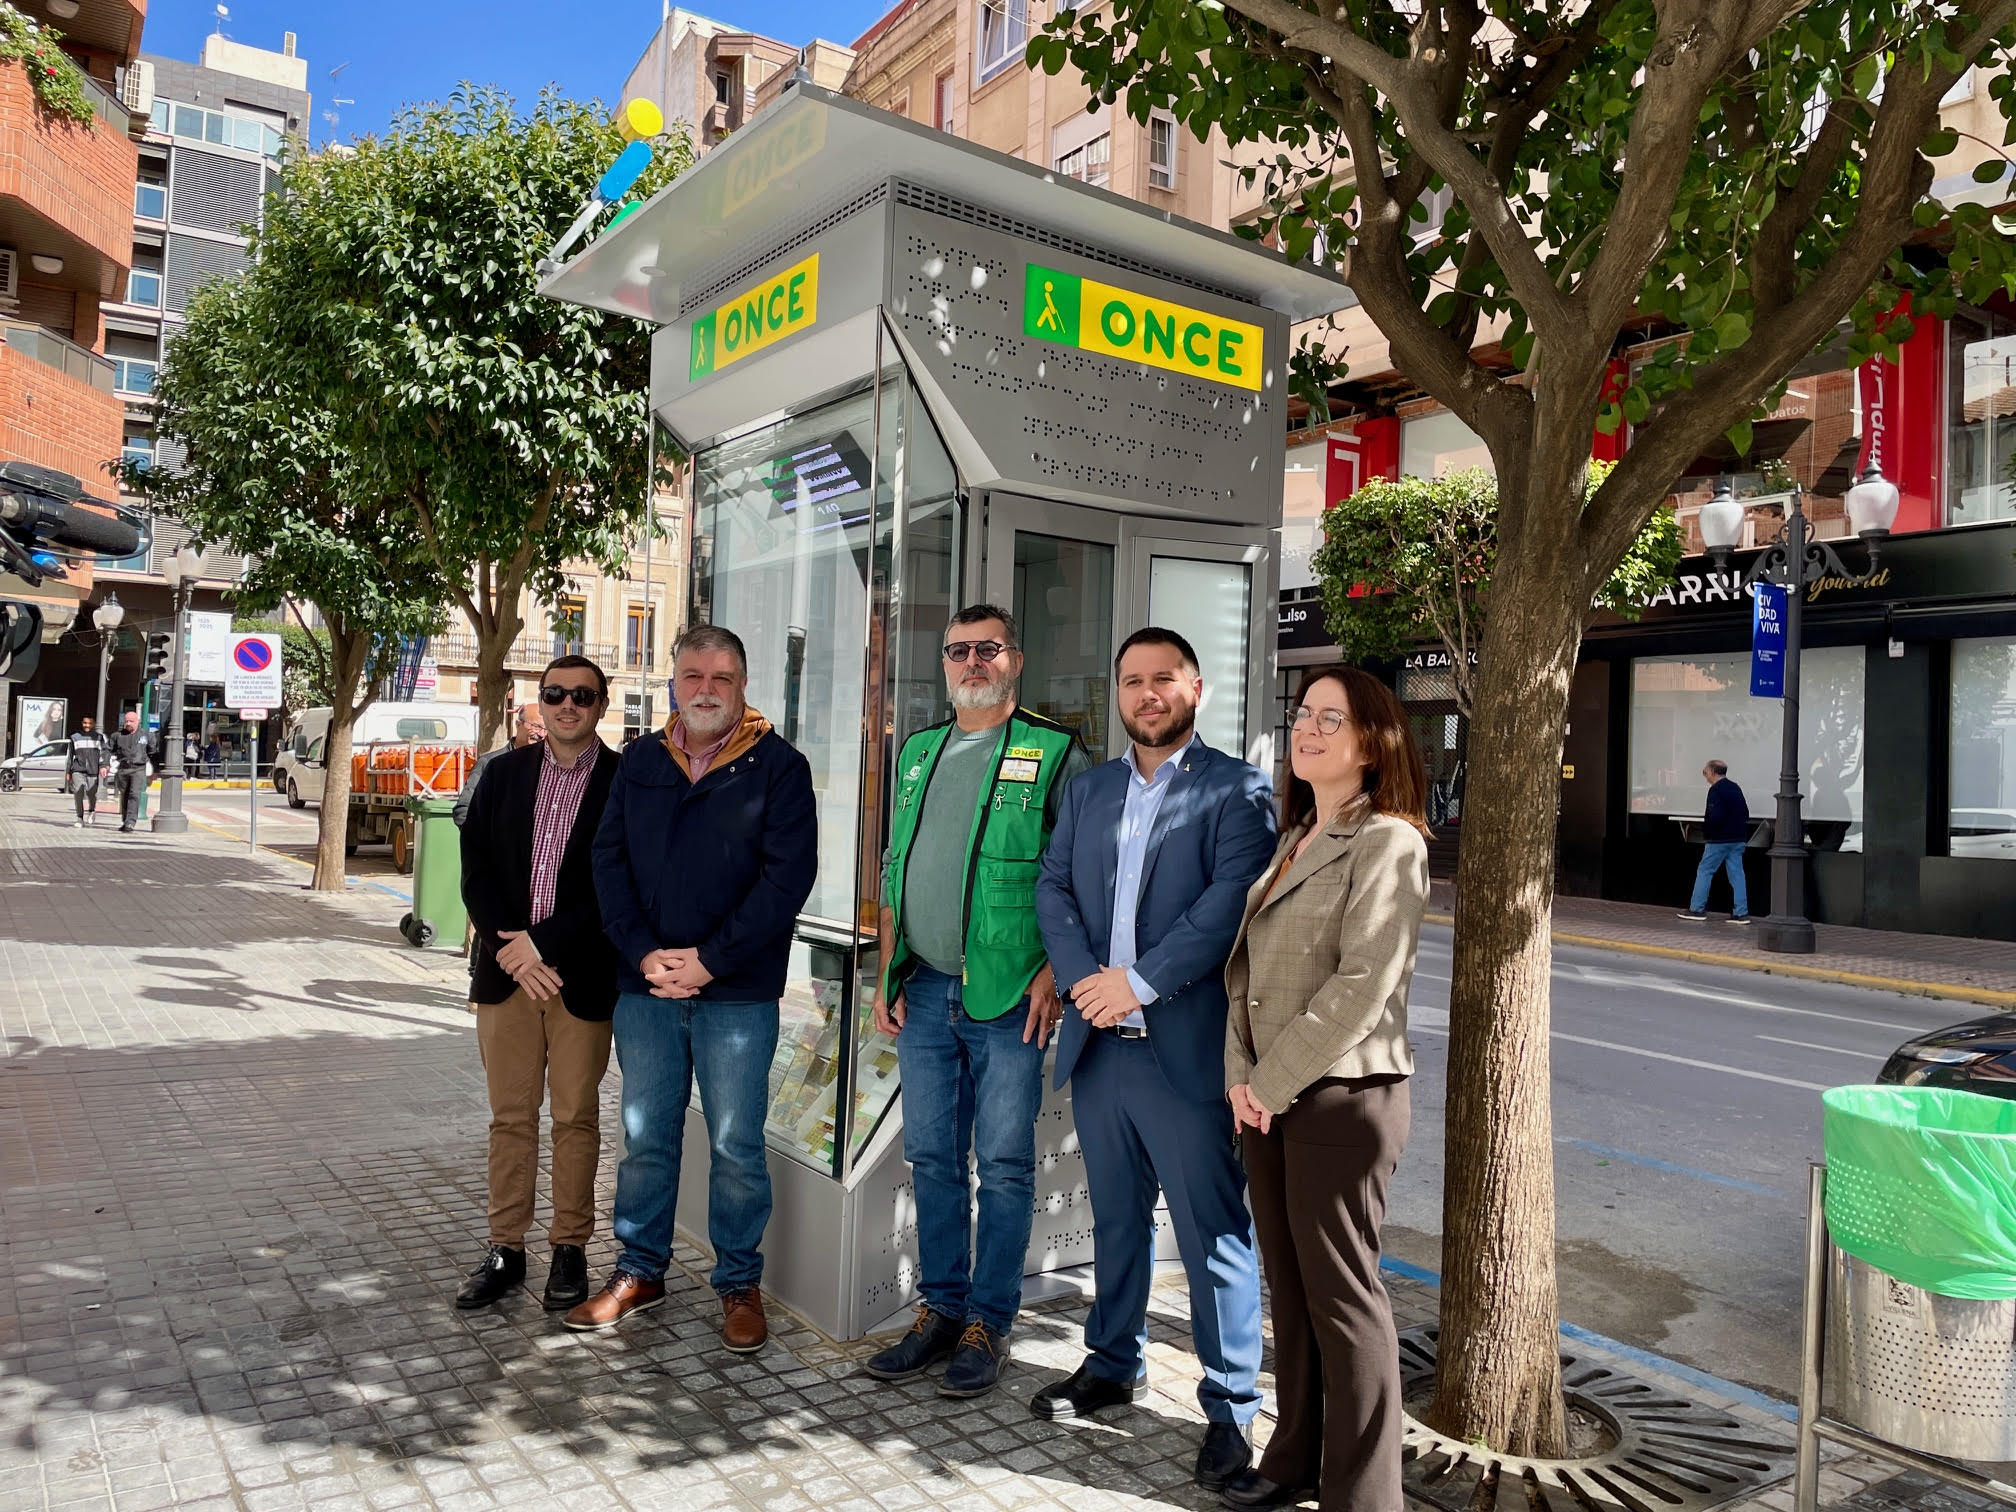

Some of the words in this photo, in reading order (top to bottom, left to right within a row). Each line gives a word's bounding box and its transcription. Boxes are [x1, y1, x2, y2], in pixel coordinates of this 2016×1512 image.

[724, 271, 806, 352] ONCE
[1101, 300, 1244, 377] ONCE
[1758, 594, 1772, 607] CIV
[1761, 621, 1780, 634] VIVA
[1013, 749, 1040, 758] ONCE
